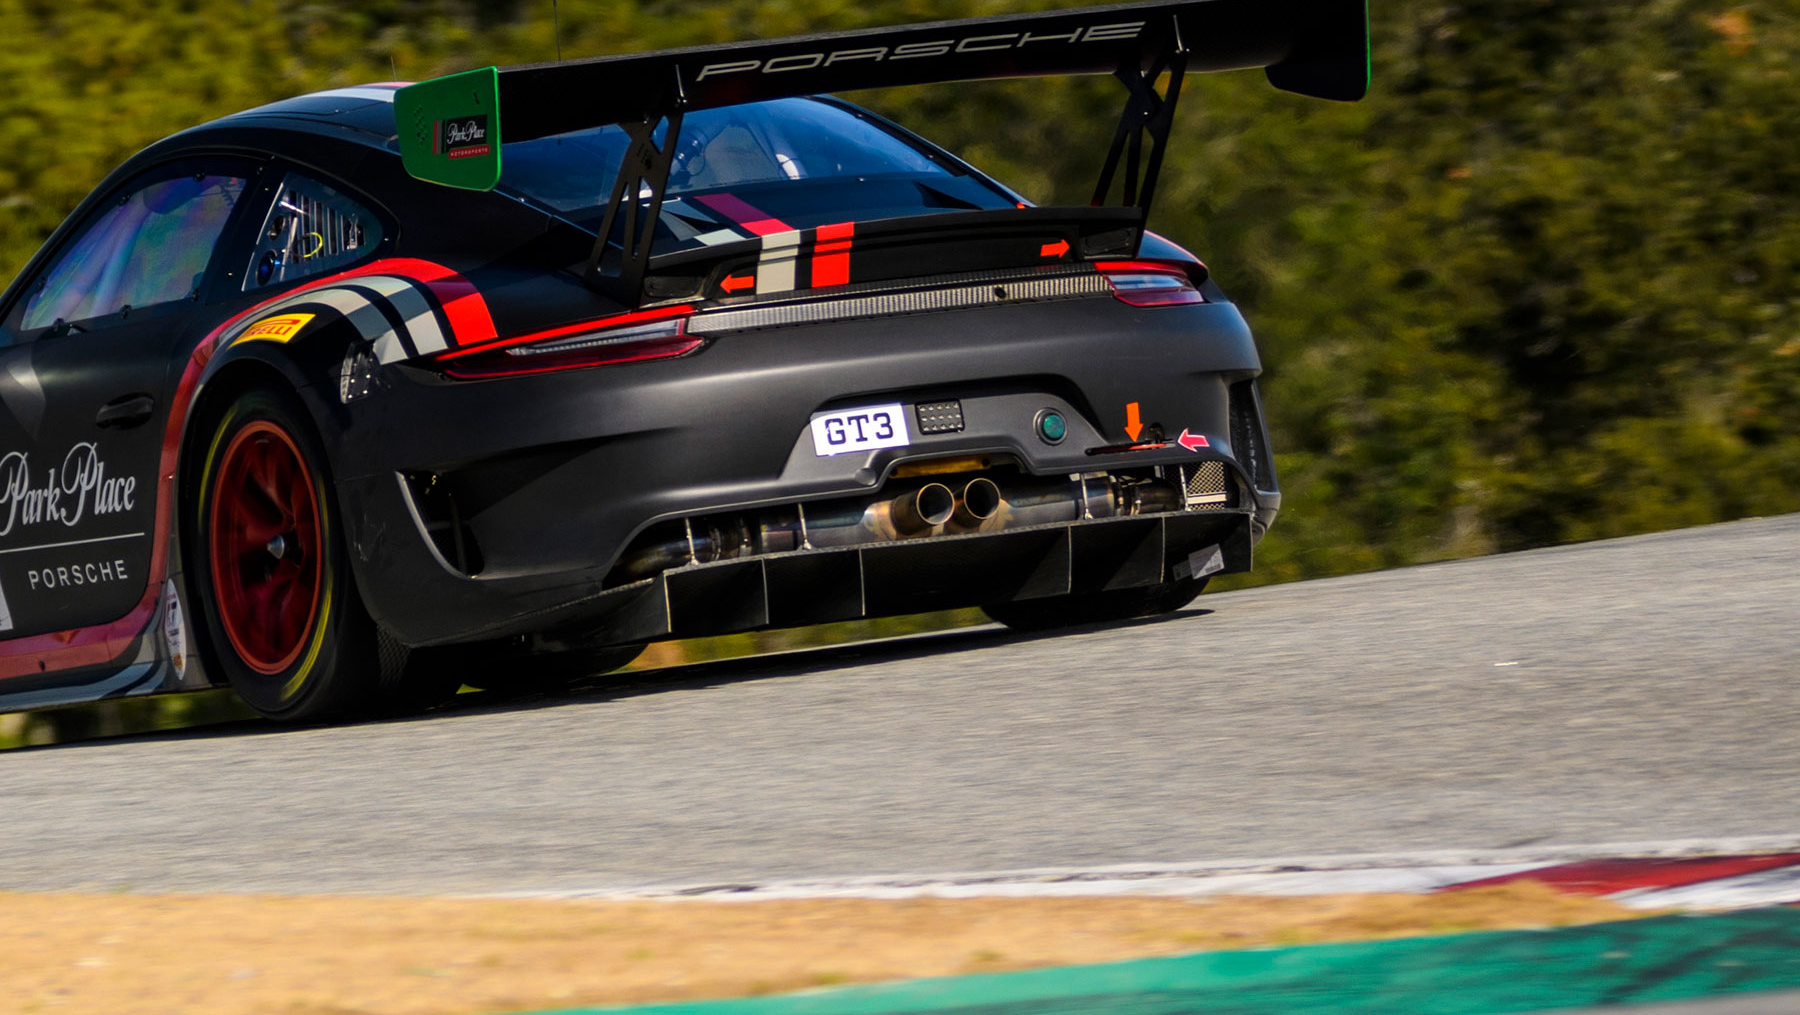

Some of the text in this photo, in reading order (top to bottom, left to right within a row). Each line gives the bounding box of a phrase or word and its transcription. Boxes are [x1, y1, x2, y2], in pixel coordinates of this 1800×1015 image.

[696, 21, 1146, 82] PORSCHE
[446, 122, 467, 145] Park
[824, 411, 895, 446] GT3
[60, 442, 136, 527] Place
[28, 559, 129, 590] PORSCHE
